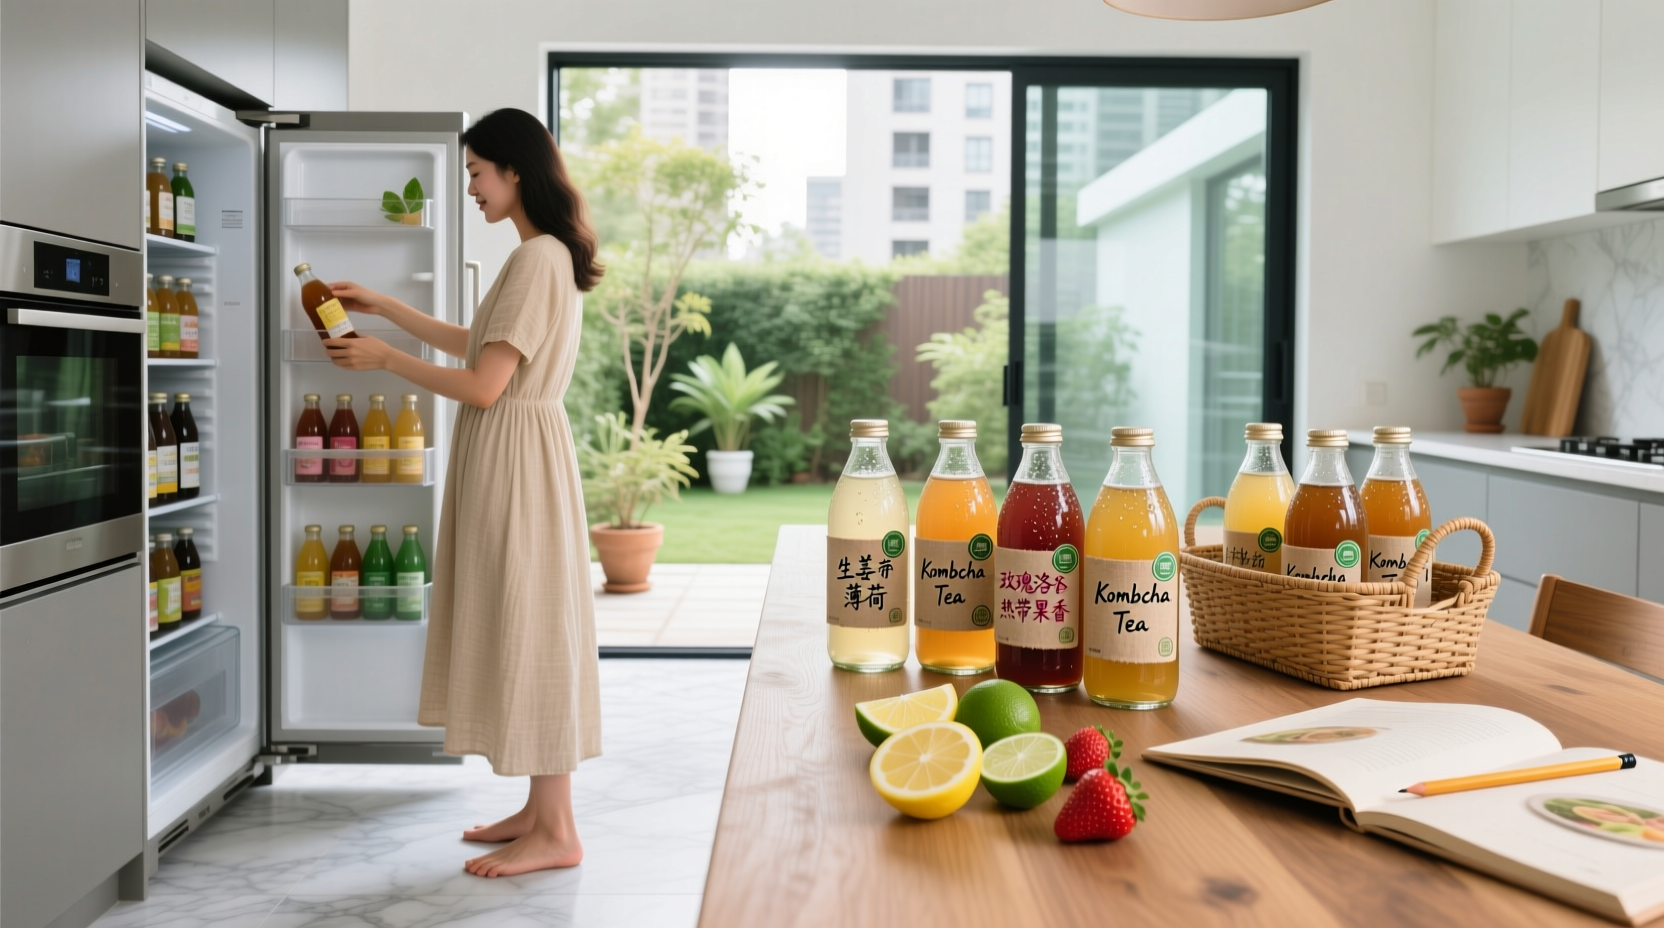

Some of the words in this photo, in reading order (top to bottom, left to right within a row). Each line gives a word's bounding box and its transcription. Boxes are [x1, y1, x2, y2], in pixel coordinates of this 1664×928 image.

[921, 558, 985, 580] Kombcha
[1370, 550, 1409, 569] Komb
[844, 583, 888, 611] 薄荷
[934, 584, 966, 606] Tea
[1095, 581, 1171, 604] Kombcha
[999, 598, 1070, 623] 热带果香
[1113, 611, 1149, 634] Tea
